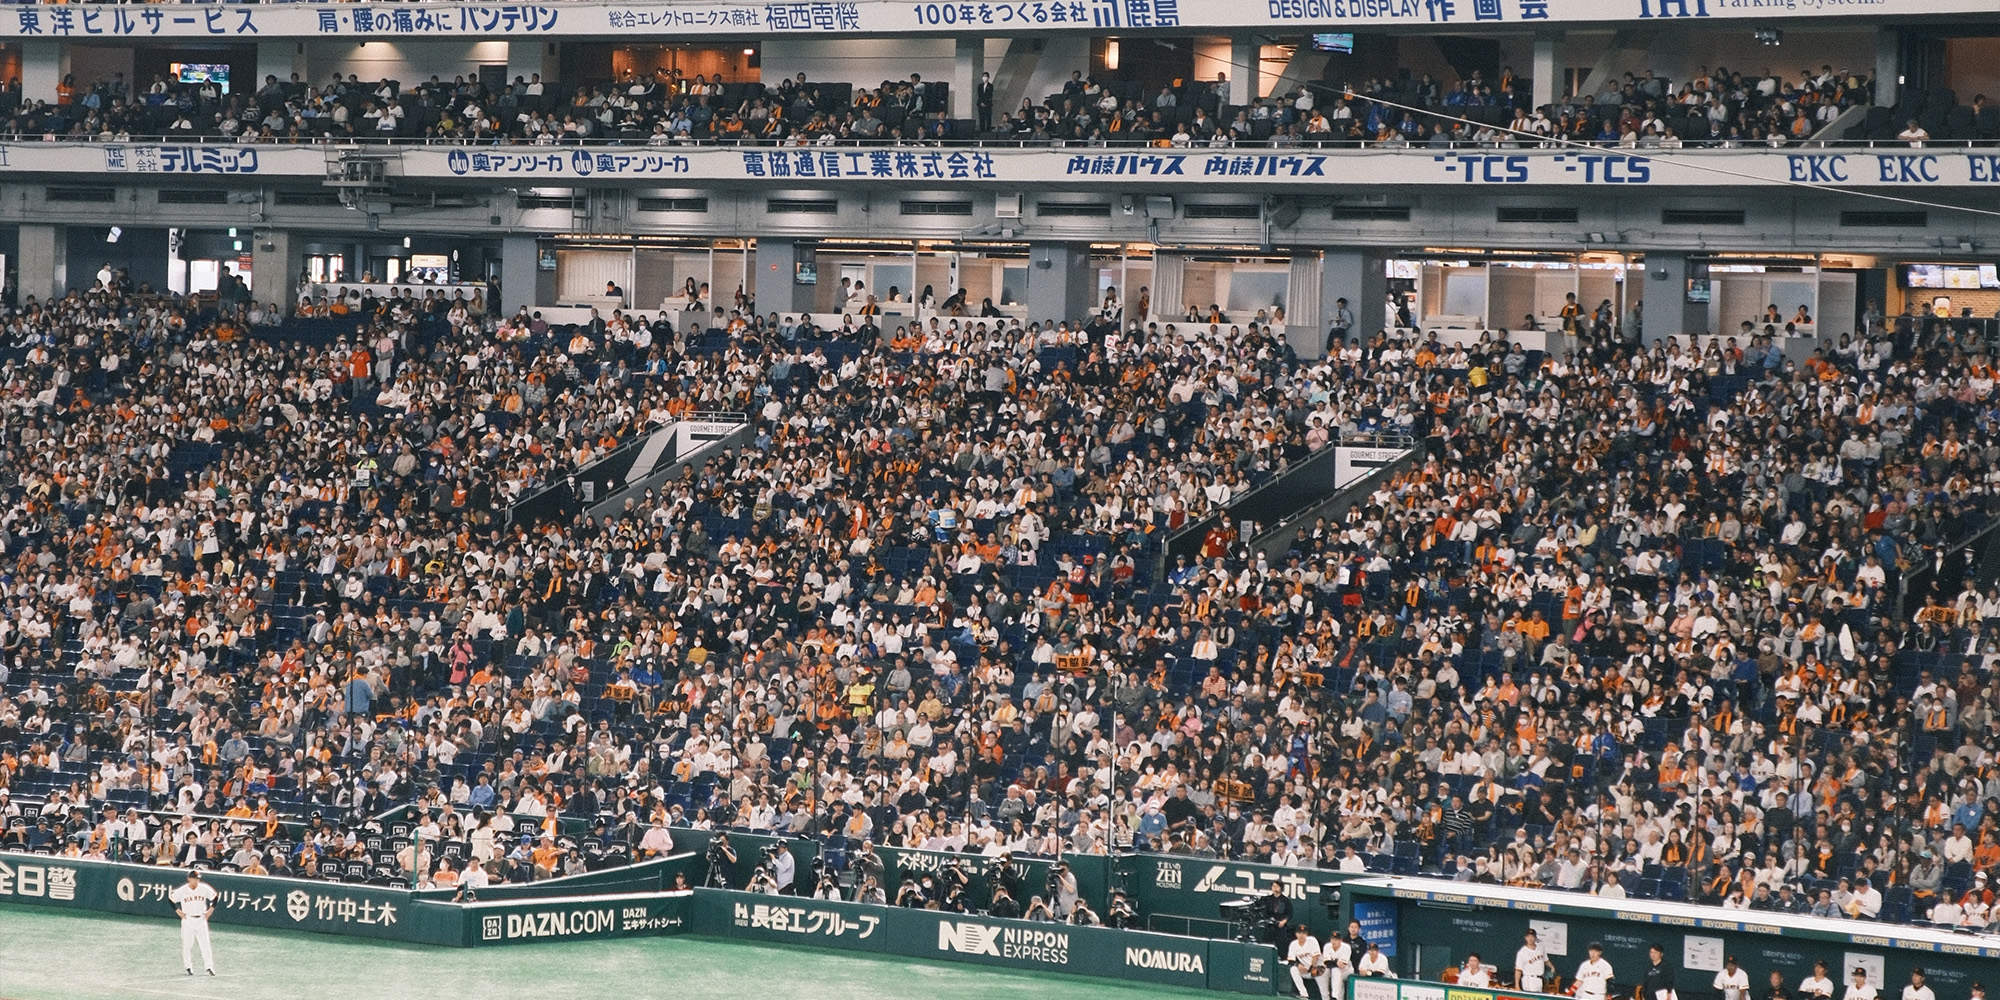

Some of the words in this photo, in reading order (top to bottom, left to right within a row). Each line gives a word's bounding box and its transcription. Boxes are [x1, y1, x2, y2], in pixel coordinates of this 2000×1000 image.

[18, 7, 258, 36] 東洋ビルサービス
[318, 9, 452, 33] 肩・腰の痛みに
[460, 6, 558, 33] バンテリン
[608, 9, 761, 29] 総合エレクトロニクス商社
[765, 3, 860, 31] 福西電機
[914, 2, 1089, 25] 100年をつくる会社
[1269, 0, 1332, 19] DESIGN
[1335, 1, 1347, 18] &
[1350, 0, 1420, 18] DISPLAY
[107, 148, 125, 158] TEL
[107, 158, 126, 169] MIC
[136, 159, 158, 171] 会社
[160, 147, 258, 173] テルミック
[472, 154, 563, 172] 奥アンツーカ
[597, 154, 689, 173] 奥アンツーカ
[743, 151, 997, 178] 電協通信工業株式会社
[1067, 155, 1188, 175] 内藤ハウス
[1204, 155, 1327, 176] 内藤ハウス
[1458, 156, 1529, 183] TCS
[1578, 156, 1651, 183] TCS
[1787, 154, 1848, 183] EKC
[1878, 155, 1939, 183] EKC
[0, 861, 76, 900] 全日警
[1156, 870, 1182, 883] ZEN
[1234, 870, 1320, 900] ユニホー
[314, 896, 397, 926] 竹中土木
[507, 909, 614, 939] DAZN.COM
[622, 917, 682, 931] エキサイトシート
[623, 907, 647, 919] DAZN
[751, 904, 880, 939] 長谷工グループ
[1004, 927, 1069, 949] NIPPON
[1004, 942, 1068, 965] EXPRESS
[1125, 946, 1205, 974] NOMURA
